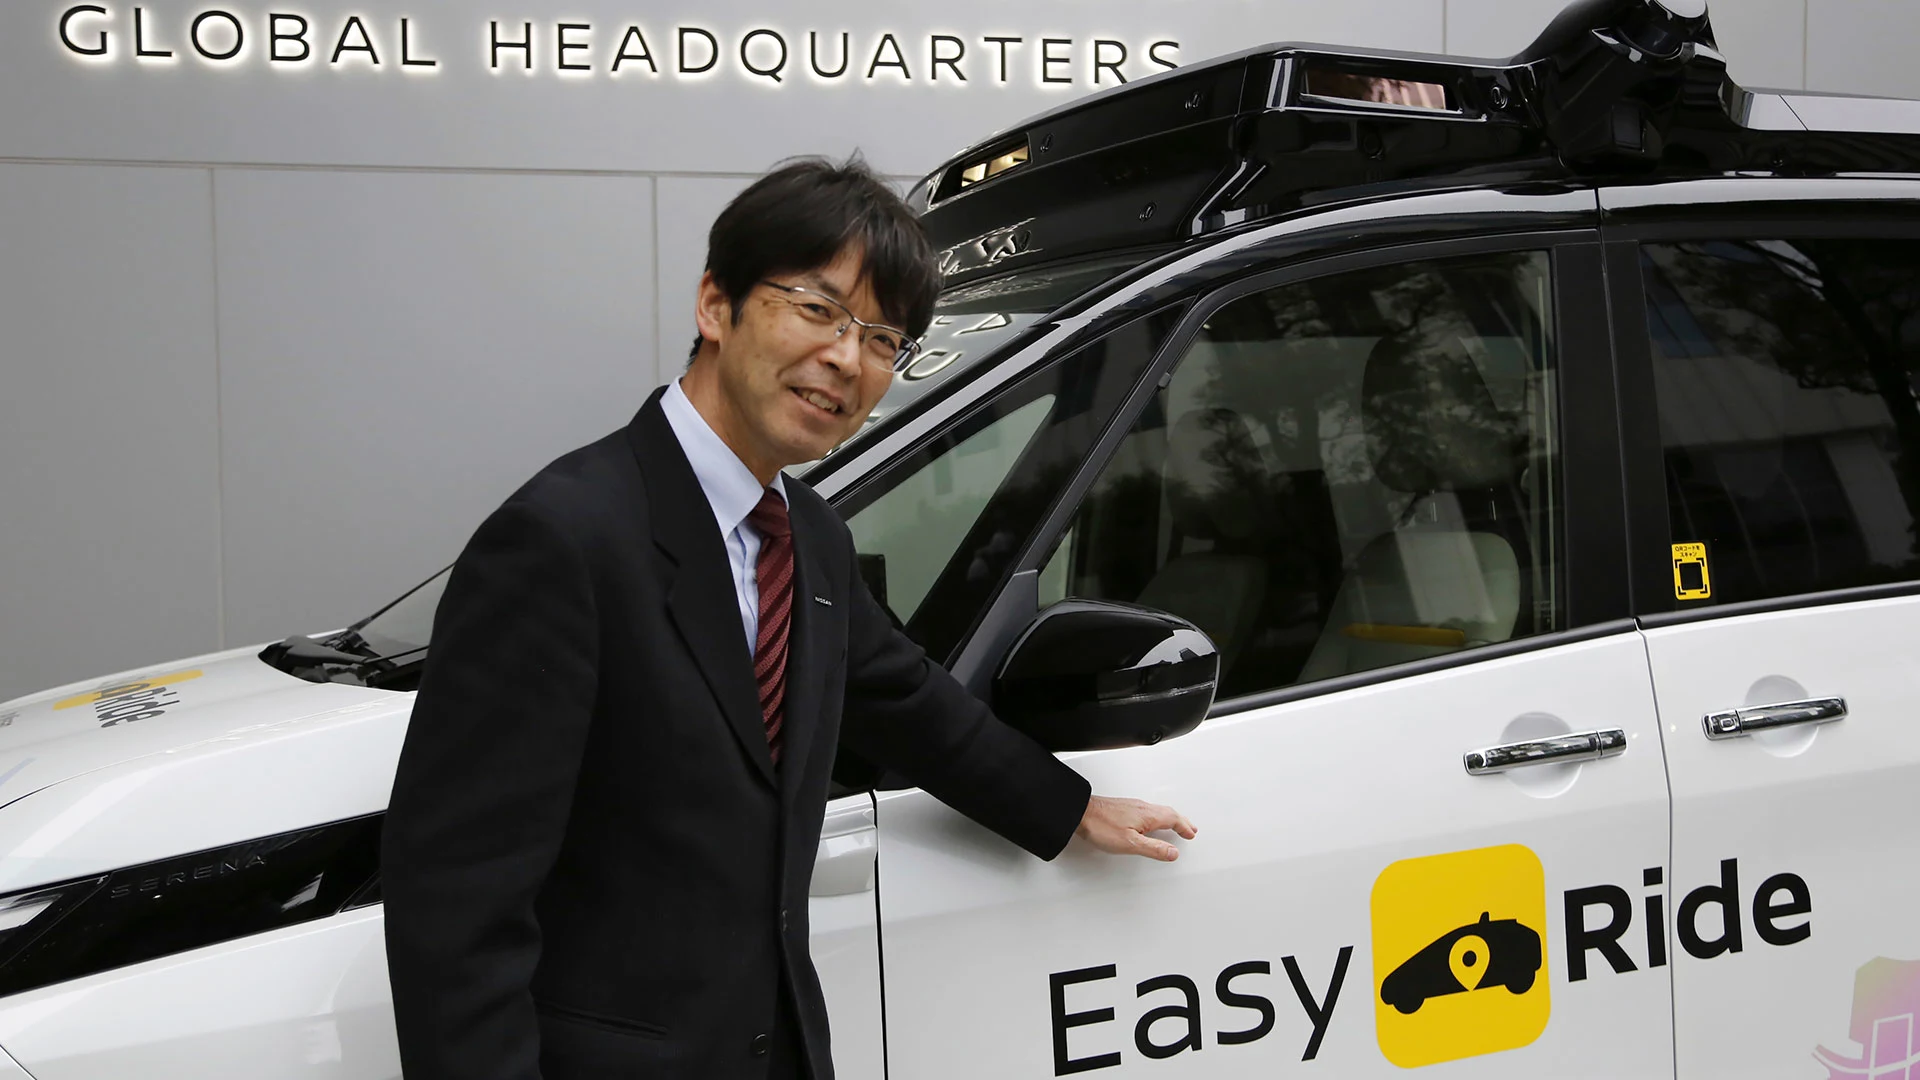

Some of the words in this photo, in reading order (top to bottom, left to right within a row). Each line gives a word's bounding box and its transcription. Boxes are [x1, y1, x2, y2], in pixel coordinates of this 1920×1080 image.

[59, 5, 436, 66] GLOBAL
[490, 21, 1180, 84] HEADQUARTERS
[111, 855, 265, 898] SERENA
[1048, 946, 1354, 1078] Easy
[1564, 858, 1812, 983] Ride
